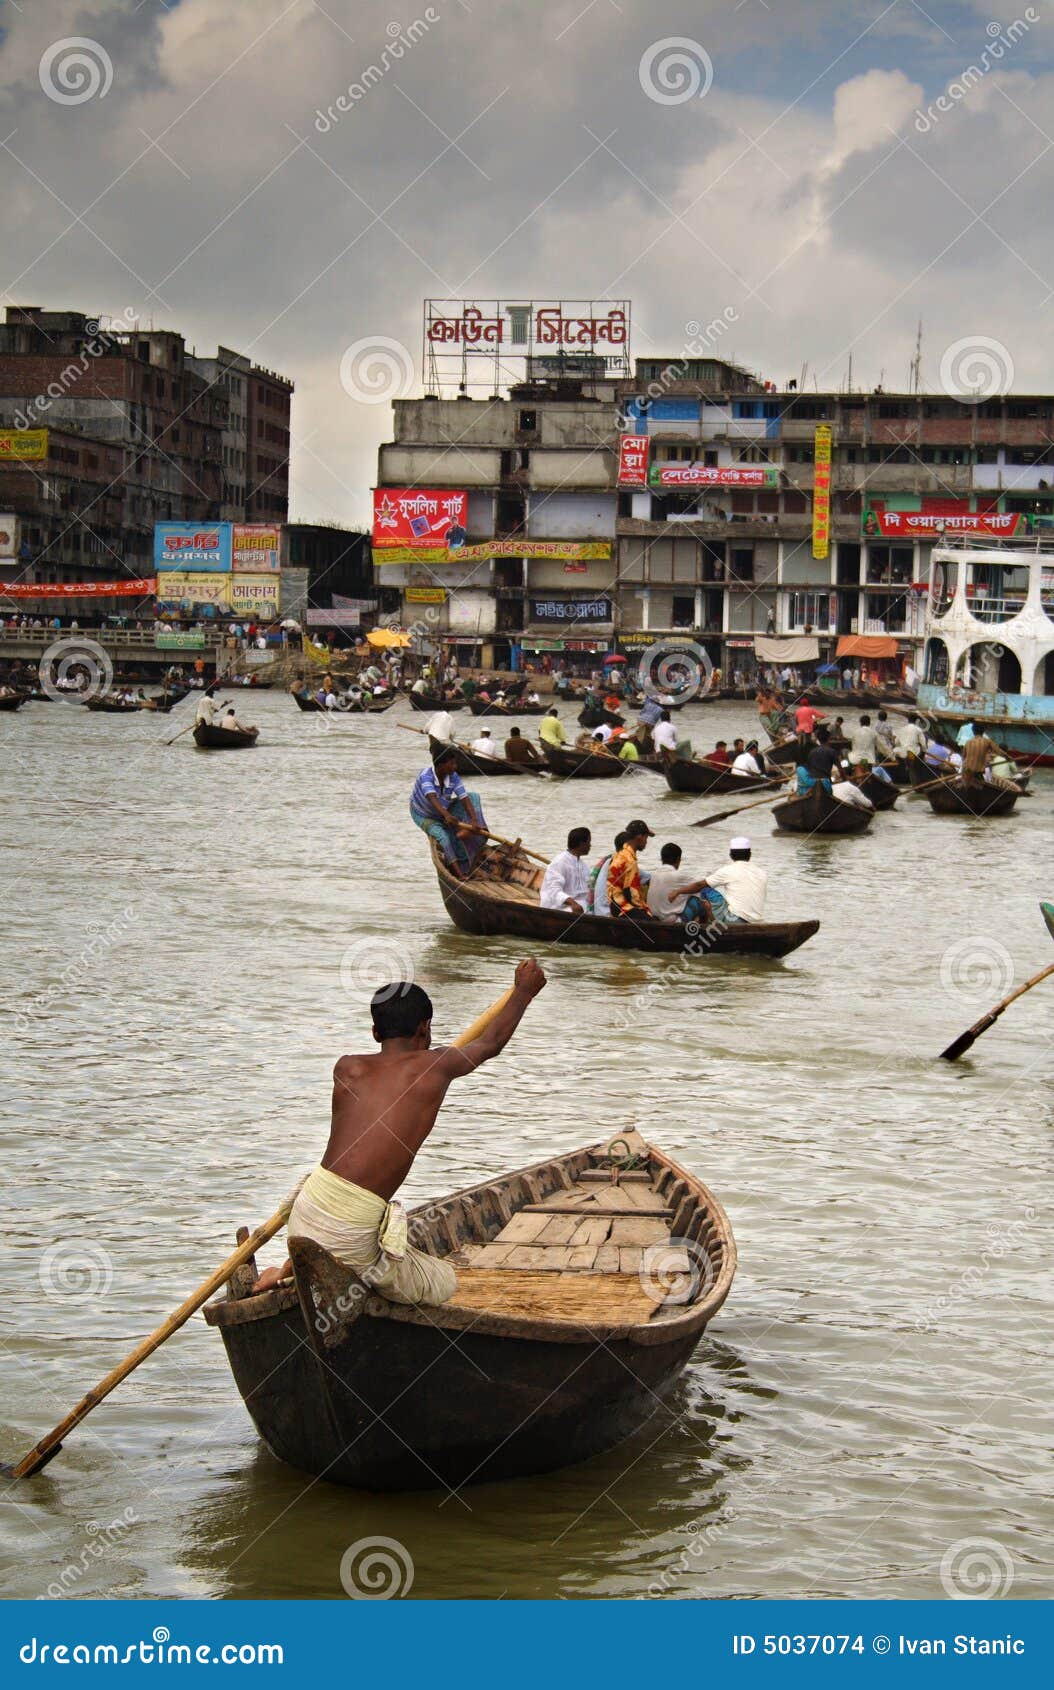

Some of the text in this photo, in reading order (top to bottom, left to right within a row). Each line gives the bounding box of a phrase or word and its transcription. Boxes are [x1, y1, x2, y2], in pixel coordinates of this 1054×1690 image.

[427, 308, 627, 344] ক্রাউন সিমেন্ট
[398, 494, 465, 519] মুসলিম শার্ট
[884, 512, 901, 528] দি
[983, 513, 1014, 528] শার্ট
[233, 585, 276, 598] আকাশ
